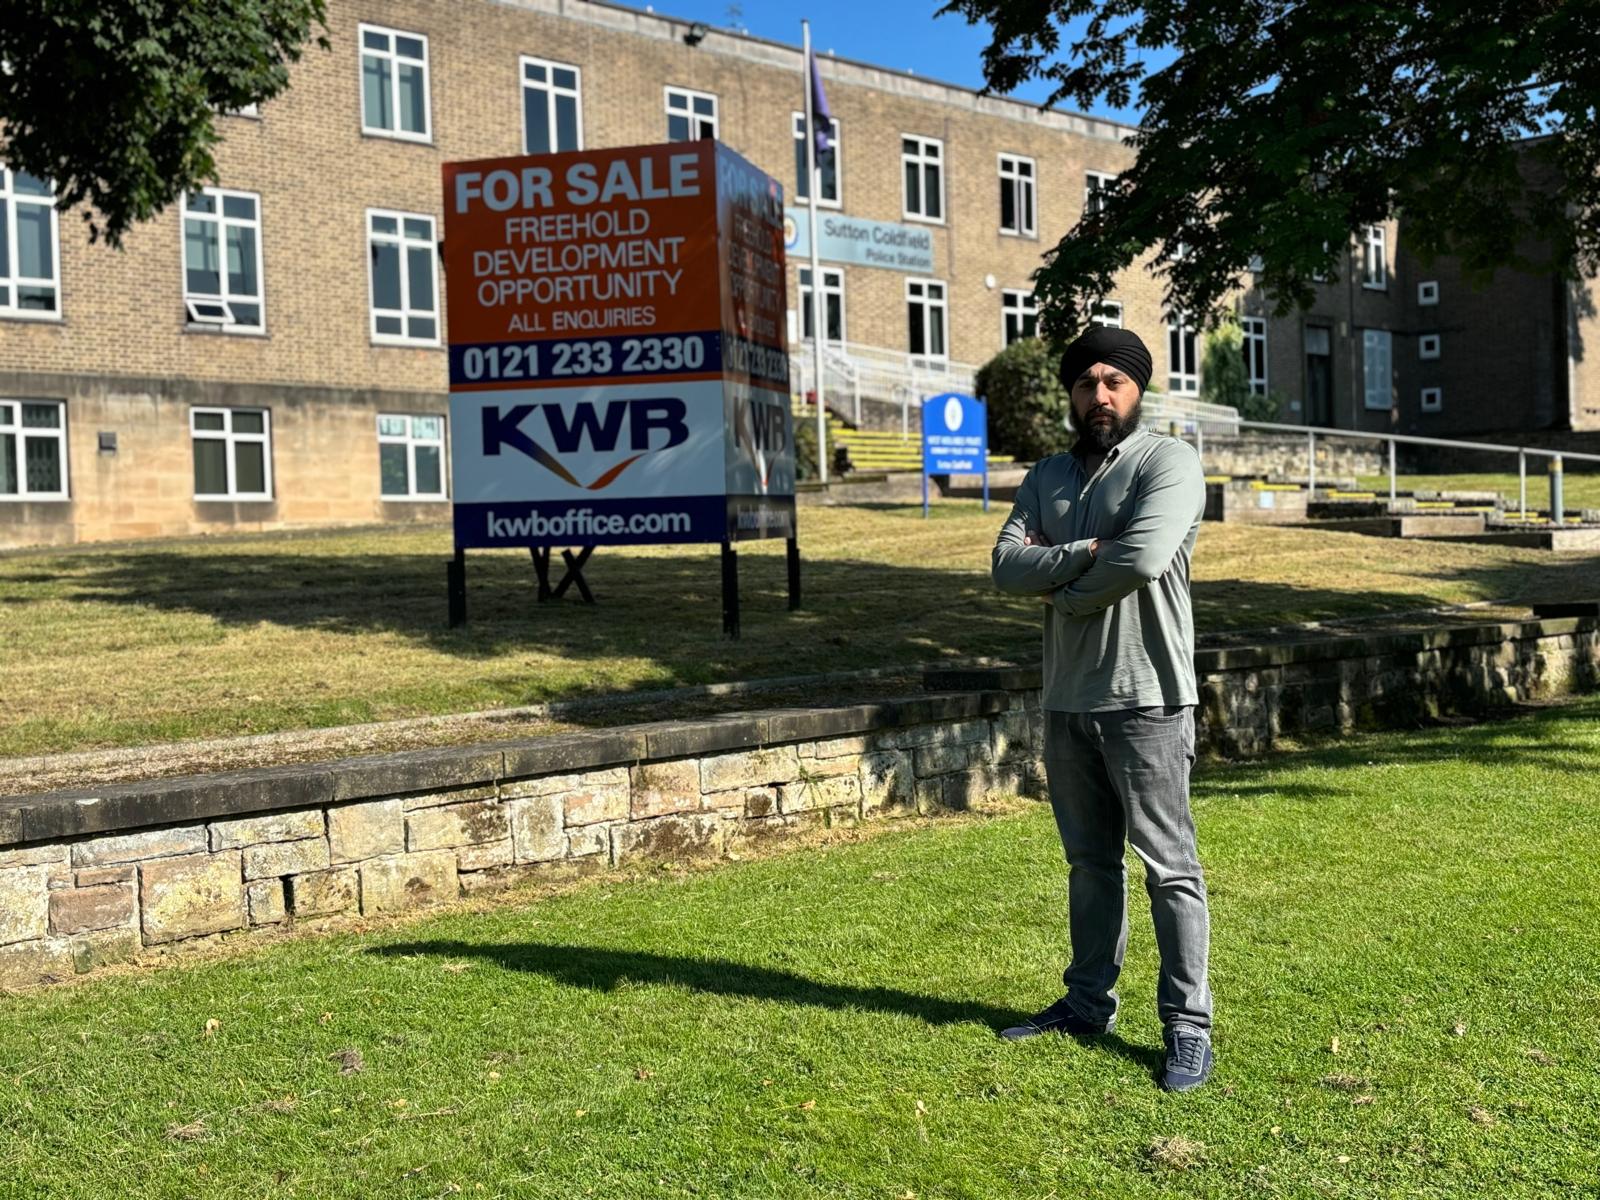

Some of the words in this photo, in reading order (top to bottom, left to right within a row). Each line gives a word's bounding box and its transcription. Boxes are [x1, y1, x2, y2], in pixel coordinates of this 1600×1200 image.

[455, 167, 554, 214] FOR
[566, 154, 700, 206] SALE
[719, 155, 746, 209] FOR
[505, 208, 650, 245] FREEHOLD
[824, 218, 869, 242] Sutton
[872, 226, 930, 250] Coldfield
[473, 236, 685, 277] DEVELOPMENT
[866, 247, 894, 263] Police
[897, 253, 930, 267] Station
[477, 269, 683, 307] OPPORTUNITY
[508, 313, 546, 333] ALL
[552, 306, 656, 331] ENQUIRIES
[463, 345, 539, 380] 0121
[551, 341, 612, 375] 233
[622, 336, 704, 372] 2330
[481, 397, 690, 489] KWB
[733, 396, 787, 466] KWB
[487, 508, 691, 538] kwboffice.com
